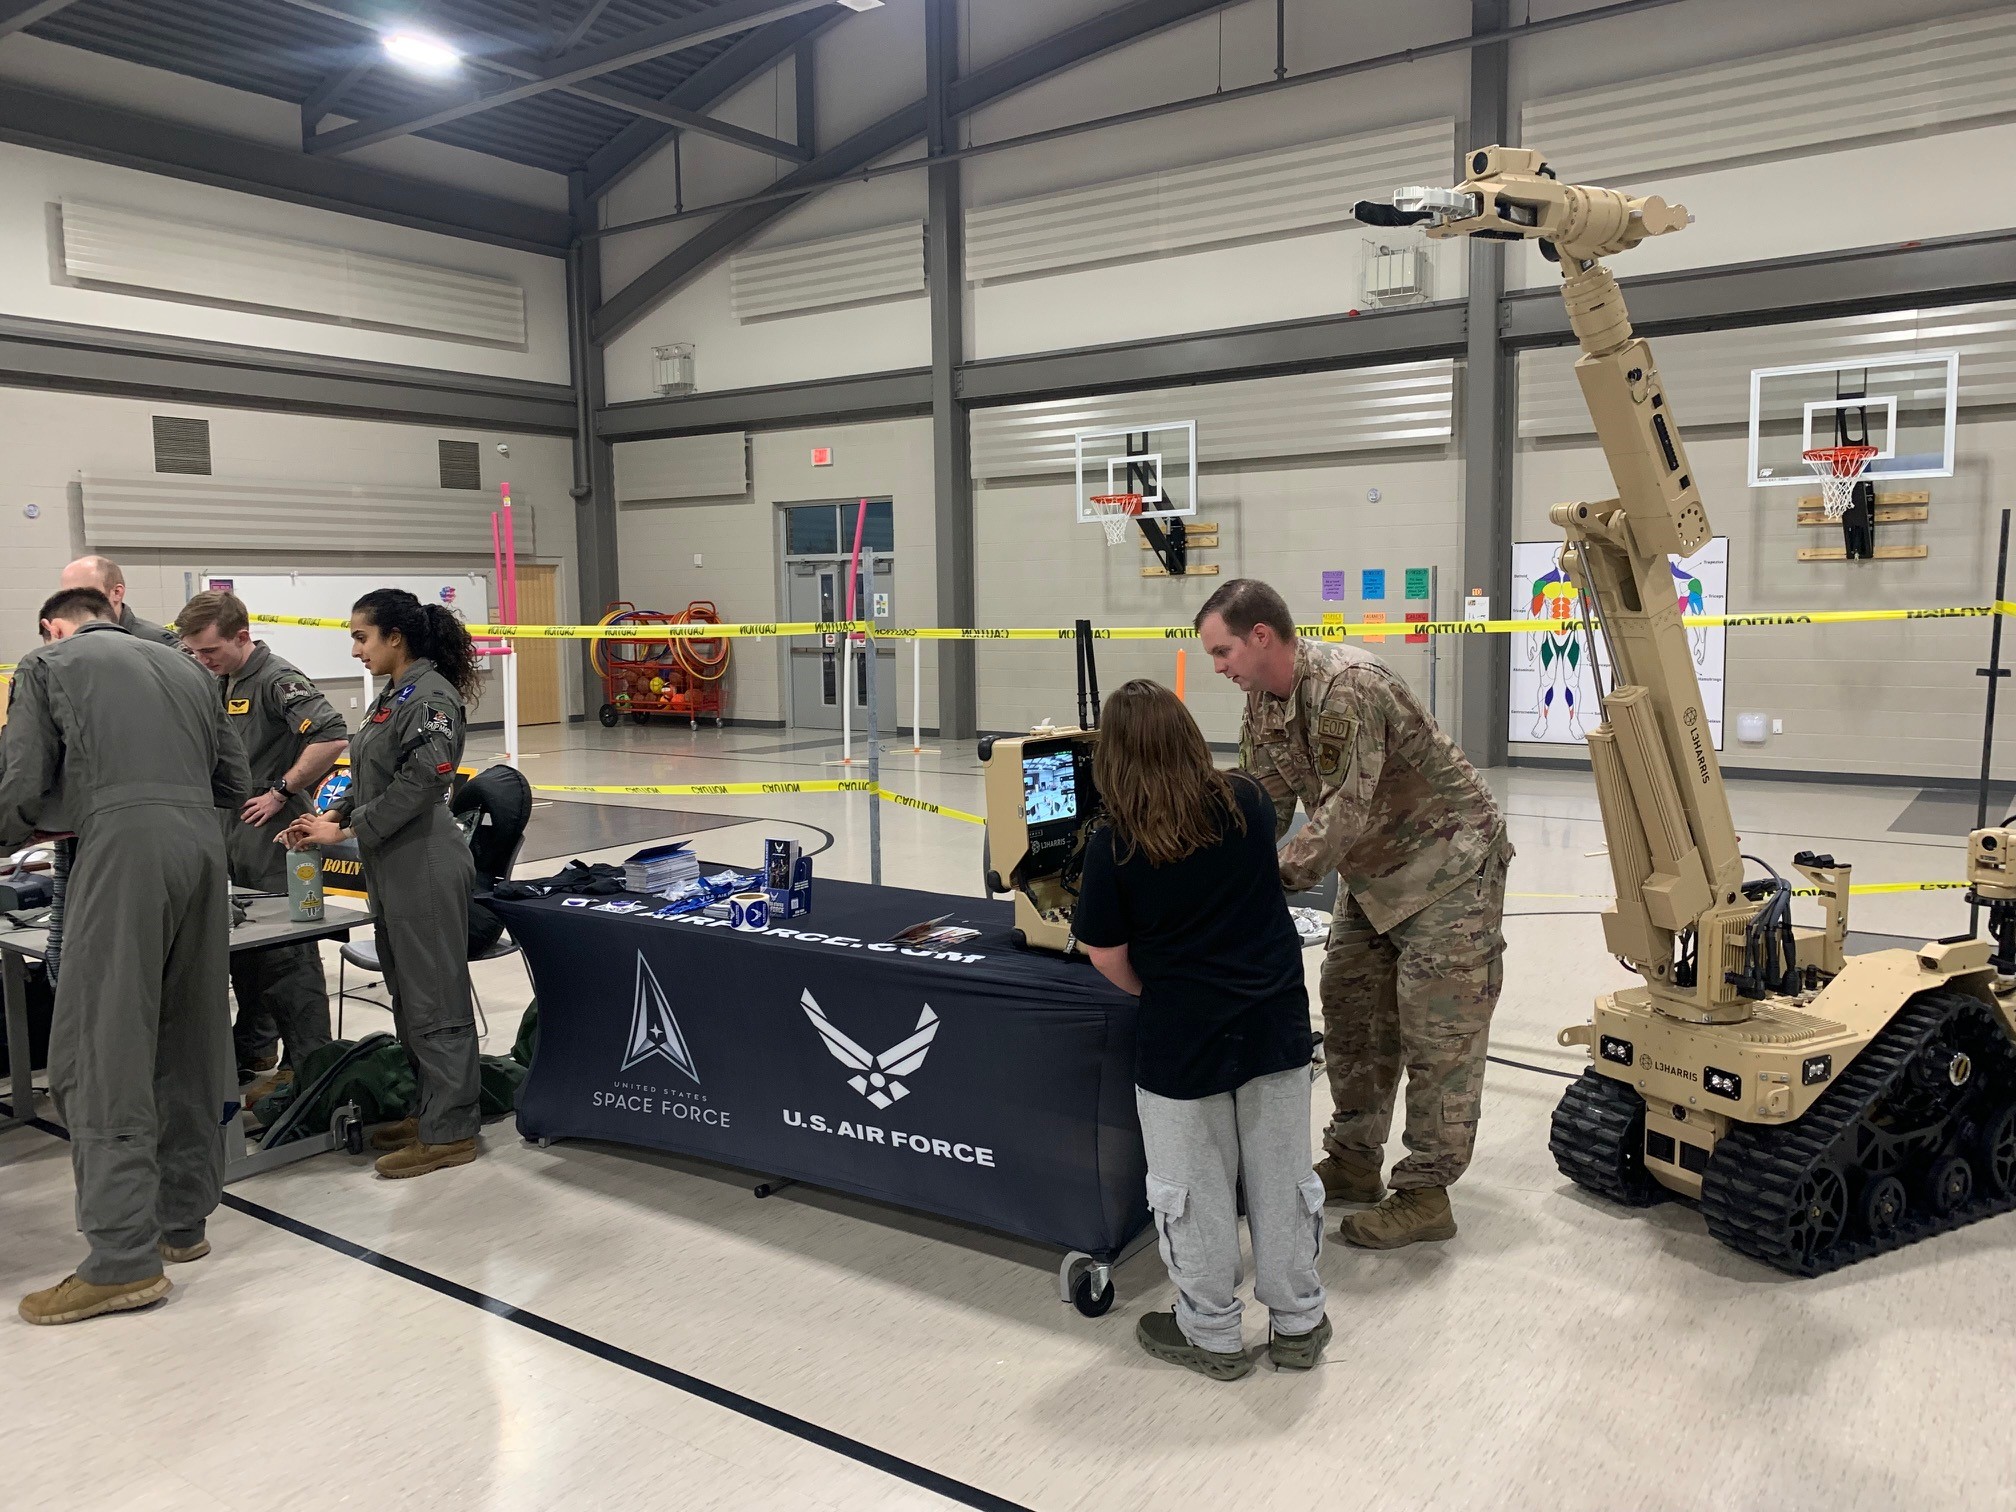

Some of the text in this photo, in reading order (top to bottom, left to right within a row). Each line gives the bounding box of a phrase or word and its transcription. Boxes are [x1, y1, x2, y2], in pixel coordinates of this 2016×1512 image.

[1322, 719, 1345, 736] EOD
[1690, 727, 1710, 784] L3HARRIS
[1040, 838, 1066, 849] L3HARRIS
[1654, 1061, 1698, 1082] L3HARRIS
[614, 1081, 708, 1102] UNITED STATES
[592, 1091, 731, 1128] SPACE FORCE
[782, 1109, 996, 1168] U.S. AIR FORCE
